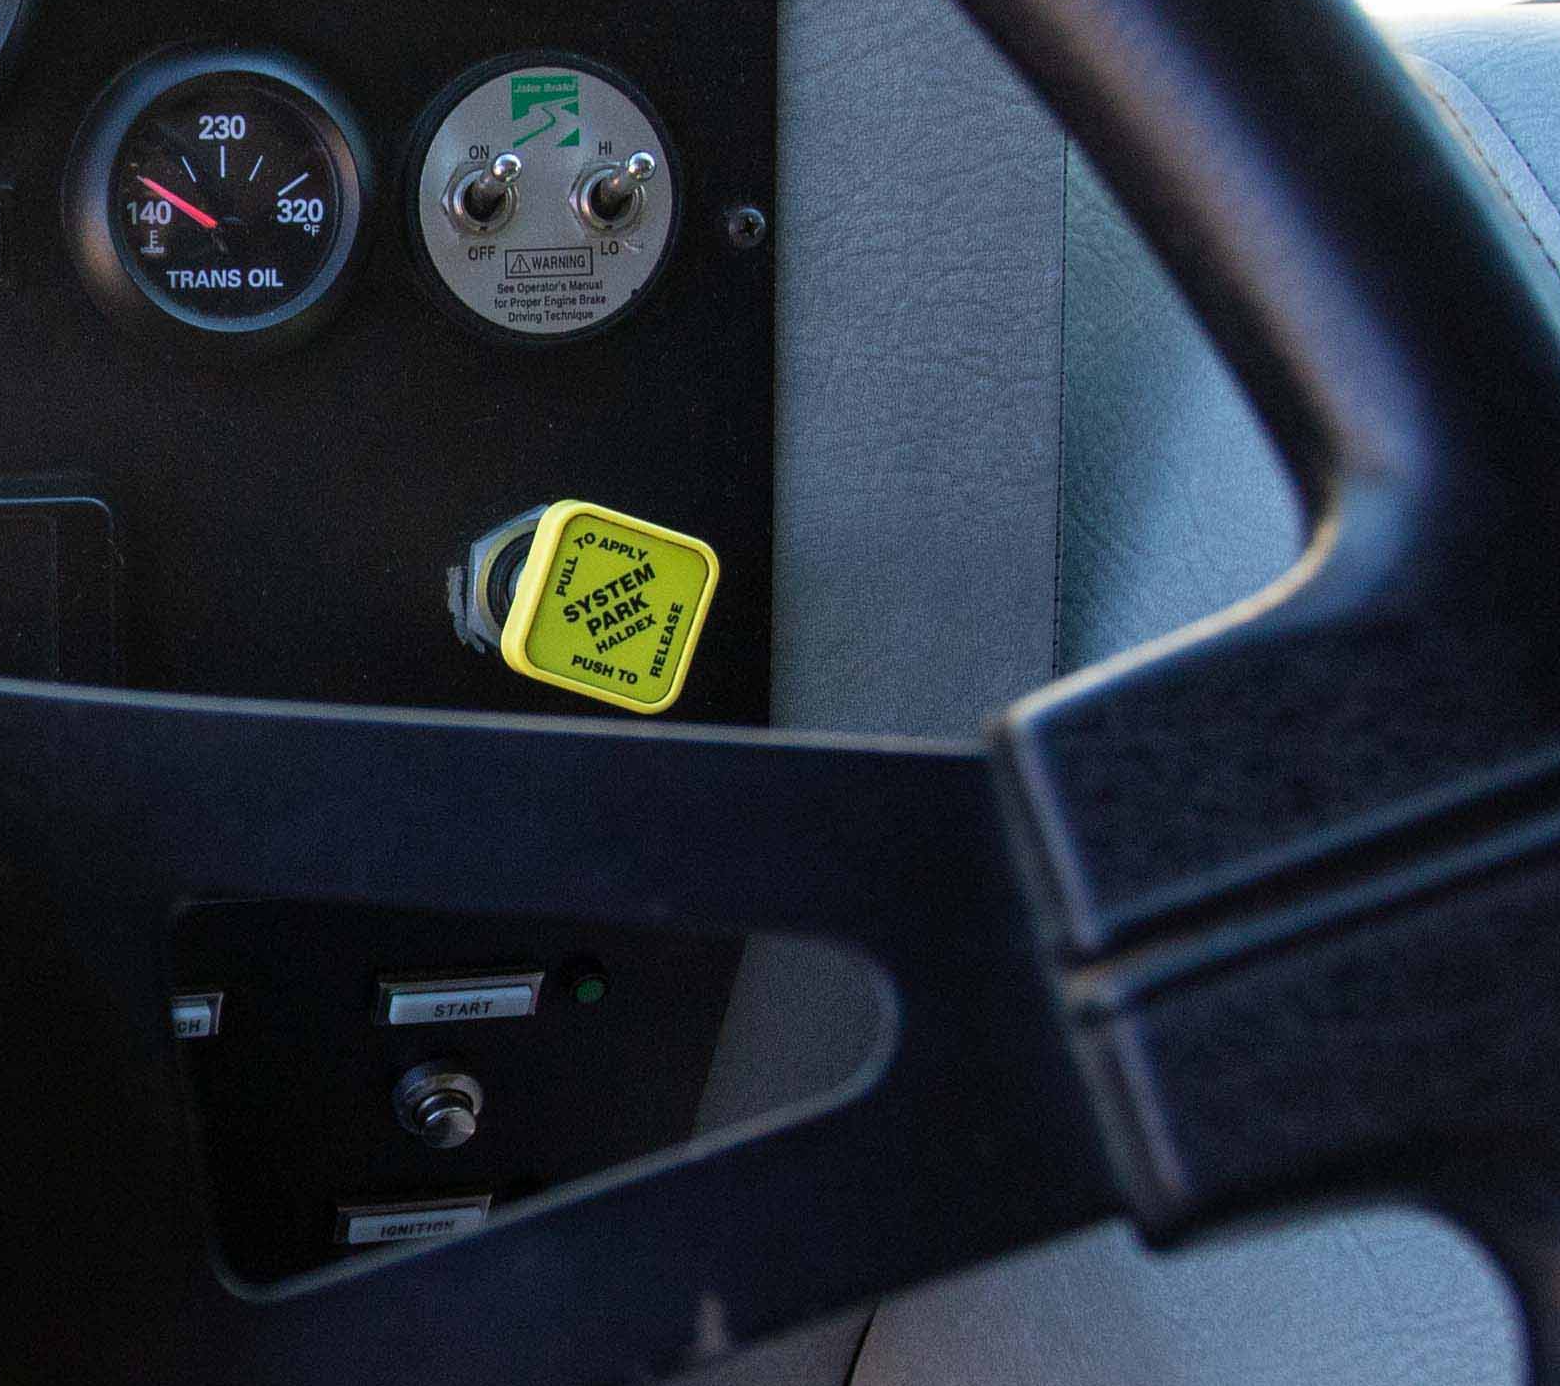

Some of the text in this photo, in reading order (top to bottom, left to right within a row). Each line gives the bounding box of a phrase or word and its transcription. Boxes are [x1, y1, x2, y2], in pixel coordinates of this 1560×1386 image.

[198, 115, 246, 140] 230
[468, 145, 489, 159] ON
[598, 141, 612, 155] HI
[127, 201, 172, 225] 140
[276, 198, 324, 223] 320
[468, 245, 496, 261] OFF
[600, 241, 619, 255] LO
[531, 254, 585, 270] WARNING
[166, 268, 284, 288] TRANS OIL
[497, 279, 603, 294] See Operator's Manual
[494, 294, 607, 309] for Proper Engine Brake
[508, 310, 594, 324] Driving Technique
[556, 532, 648, 597] PULL TO APPLY
[562, 563, 656, 624] SYSTEM
[585, 591, 650, 637] PARK
[571, 602, 684, 685] PUSH TO RELEASE
[595, 615, 658, 655] HALDEX
[434, 1000, 494, 1017] START
[381, 1220, 455, 1237] IGNITION
